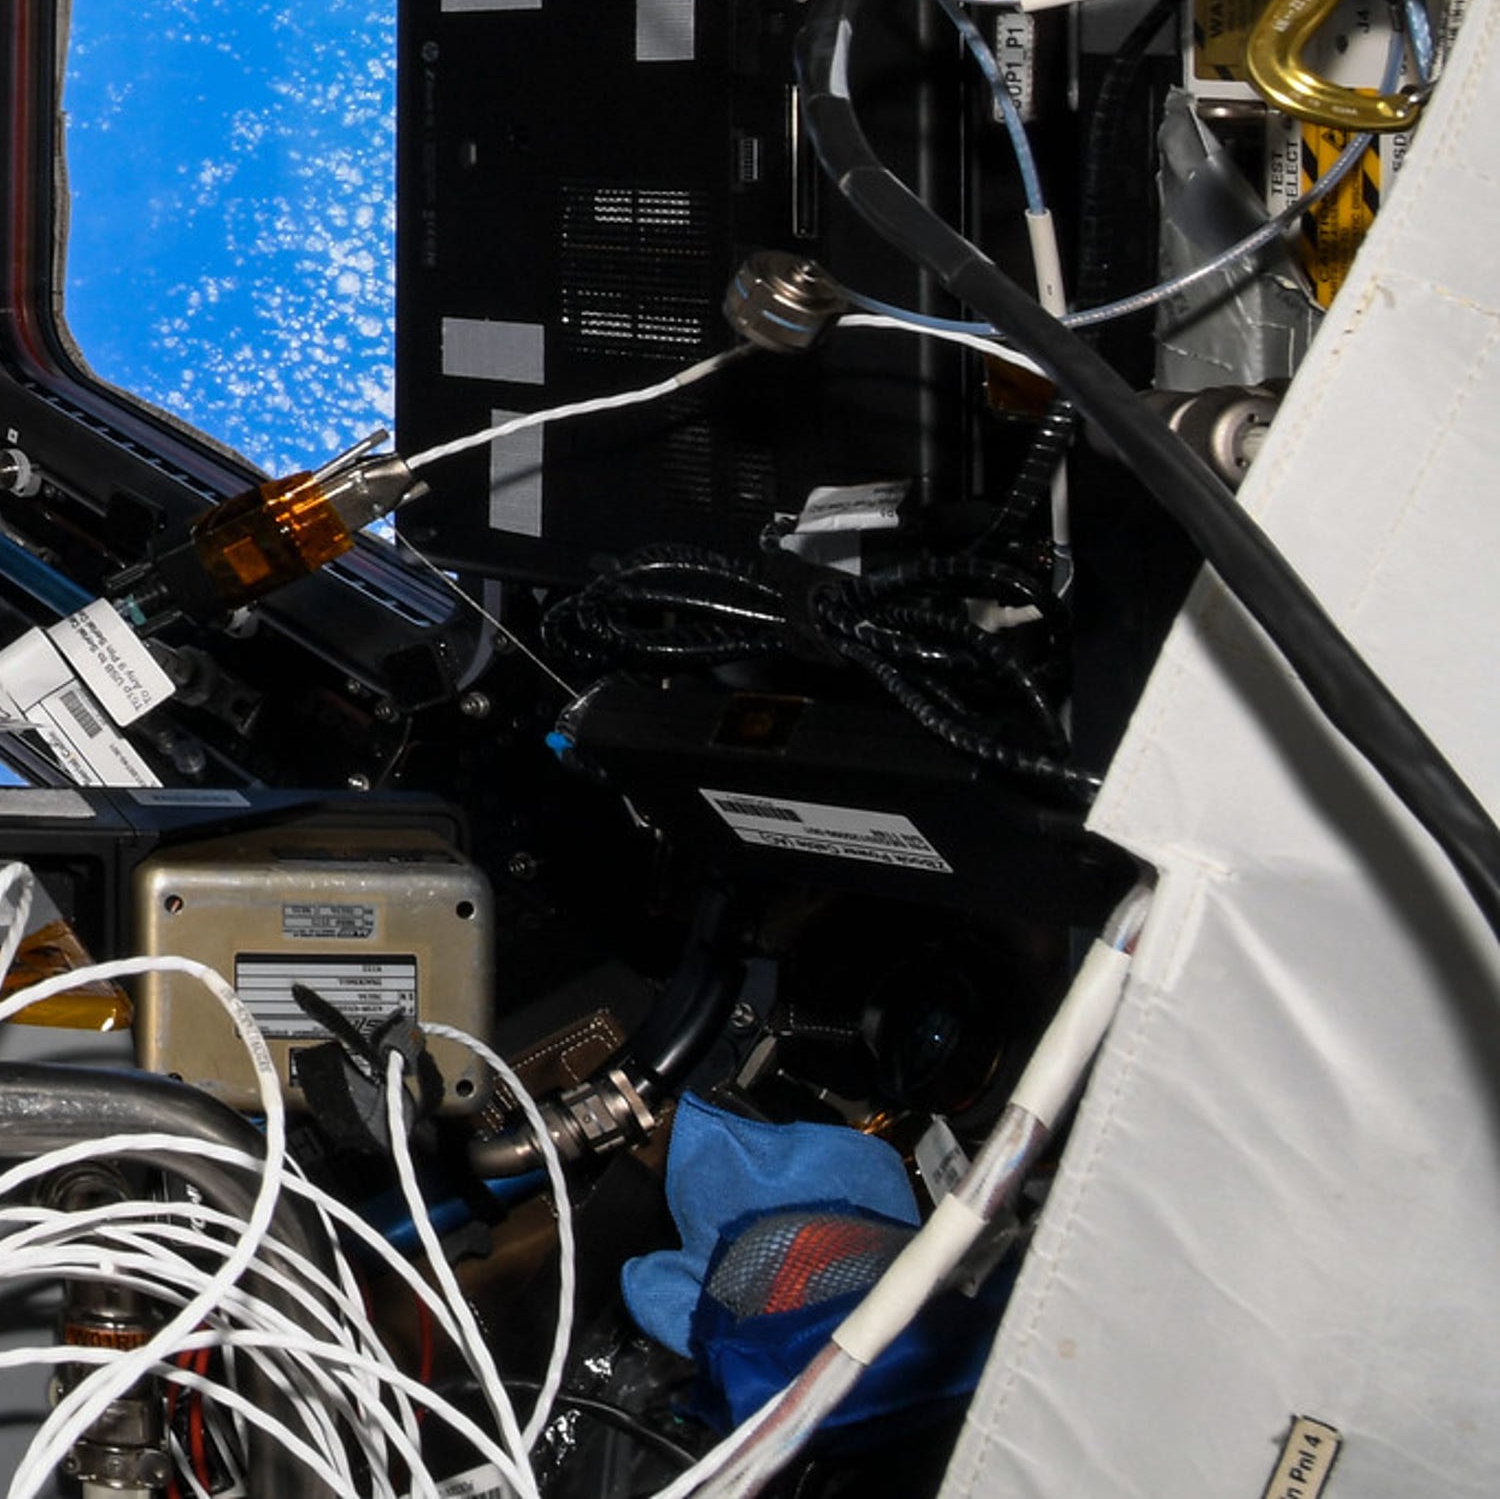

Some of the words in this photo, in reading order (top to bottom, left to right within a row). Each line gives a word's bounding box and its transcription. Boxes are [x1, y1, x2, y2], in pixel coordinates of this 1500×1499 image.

[1271, 152, 1284, 196] TEST
[1289, 1450, 1317, 1484] Pnl
[1303, 1434, 1323, 1449] 4
